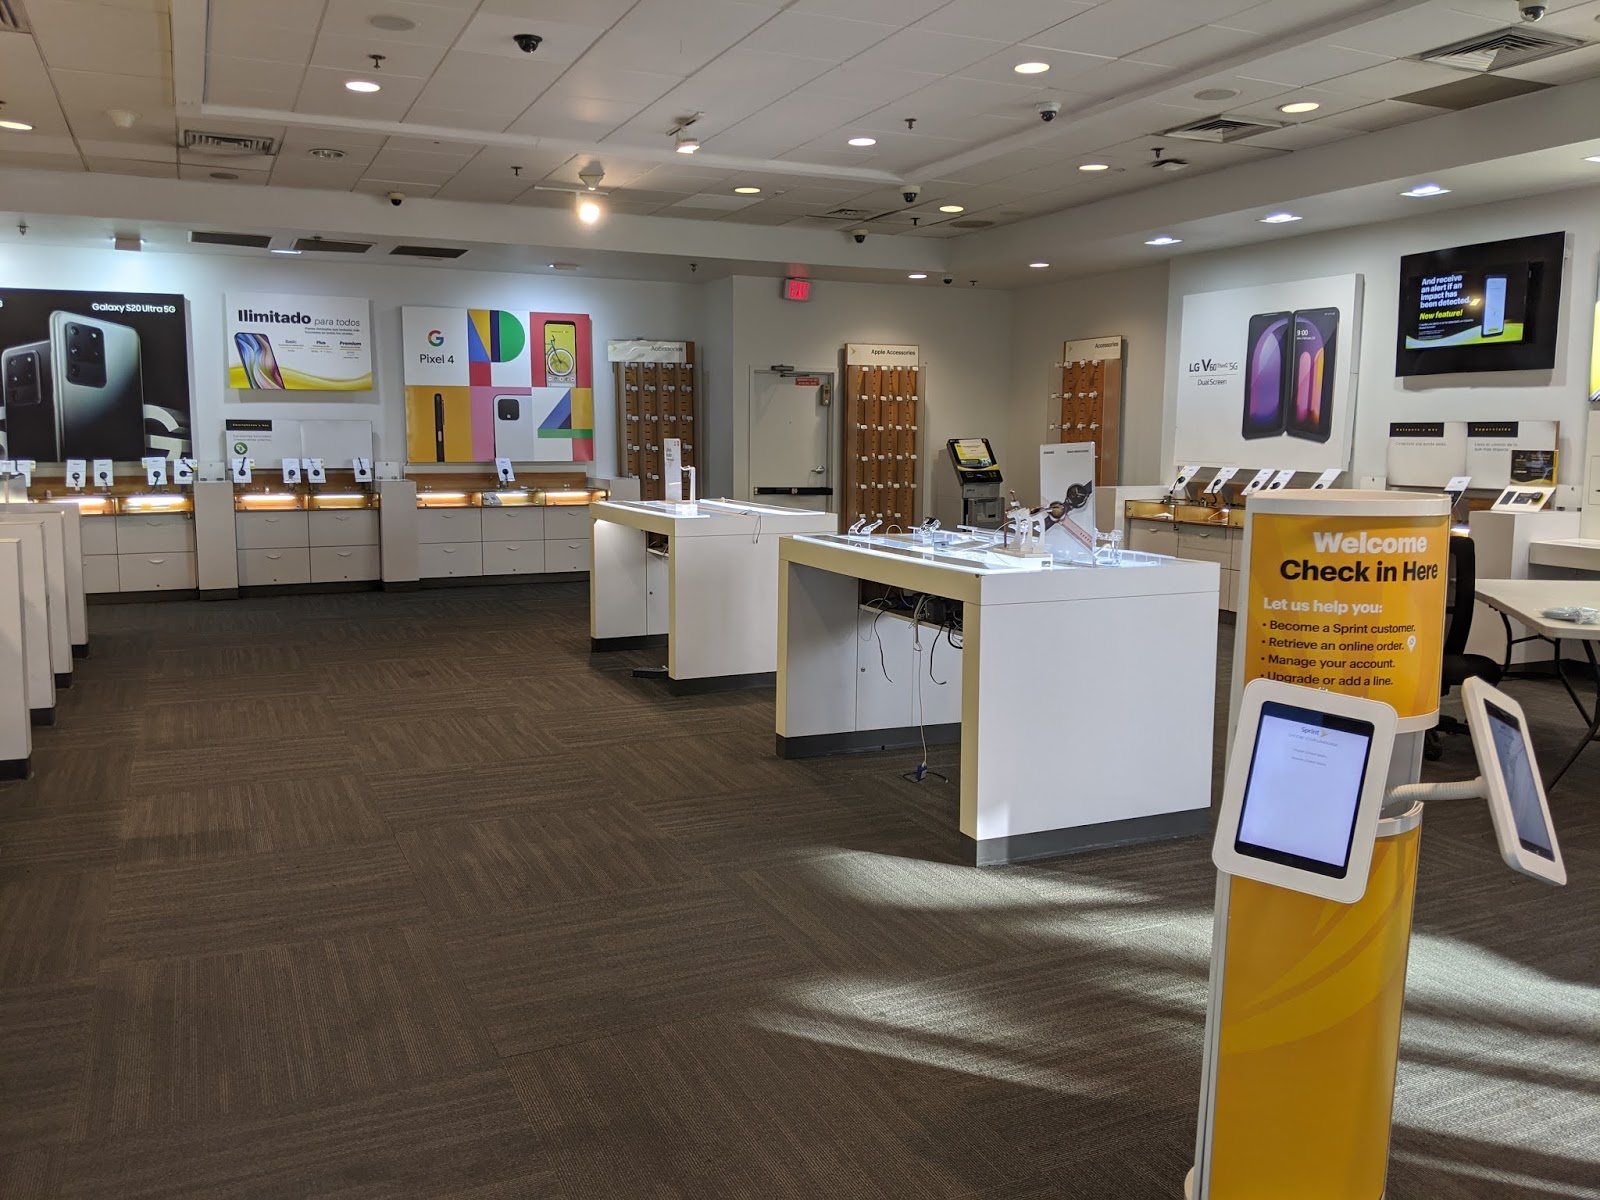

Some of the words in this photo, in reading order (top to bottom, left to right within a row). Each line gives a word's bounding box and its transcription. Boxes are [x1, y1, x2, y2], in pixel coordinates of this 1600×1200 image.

[1436, 275, 1462, 283] receive
[788, 280, 810, 300] EXIT
[1420, 301, 1437, 309] been
[1438, 297, 1470, 306] detected.
[1421, 293, 1443, 301] impact
[92, 303, 124, 314] Galaxy
[125, 304, 141, 313] S20
[142, 305, 163, 313] Ultra
[164, 305, 176, 313] 5G
[1419, 312, 1435, 320] New
[1436, 309, 1463, 319] feature!
[238, 309, 311, 325] Ilimitado
[336, 318, 360, 326] todos
[419, 354, 445, 364] Pixel
[447, 355, 454, 364] 4
[1189, 362, 1200, 372] LG
[1229, 362, 1238, 371] 5G
[1313, 532, 1428, 554] Welcome
[1280, 560, 1370, 582] Check
[1376, 561, 1397, 582] in
[1402, 561, 1438, 581] Here
[1264, 598, 1288, 611] Let
[1291, 602, 1310, 612] us
[1313, 600, 1348, 615] help
[1352, 603, 1382, 616] you:
[1270, 620, 1320, 633] Become
[1333, 623, 1368, 635] Sprint
[1370, 622, 1415, 634] customer.
[1269, 638, 1318, 649] Retrieve
[1320, 642, 1335, 650] an
[1339, 641, 1374, 651] online
[1376, 640, 1404, 651] order.
[1268, 654, 1316, 667] Manage
[1320, 659, 1346, 669] your
[1350, 659, 1395, 669] account.
[1267, 671, 1320, 684] Upgrade
[1338, 676, 1362, 686] add
[1373, 676, 1393, 686] line.
[1301, 727, 1320, 735] Sprint
